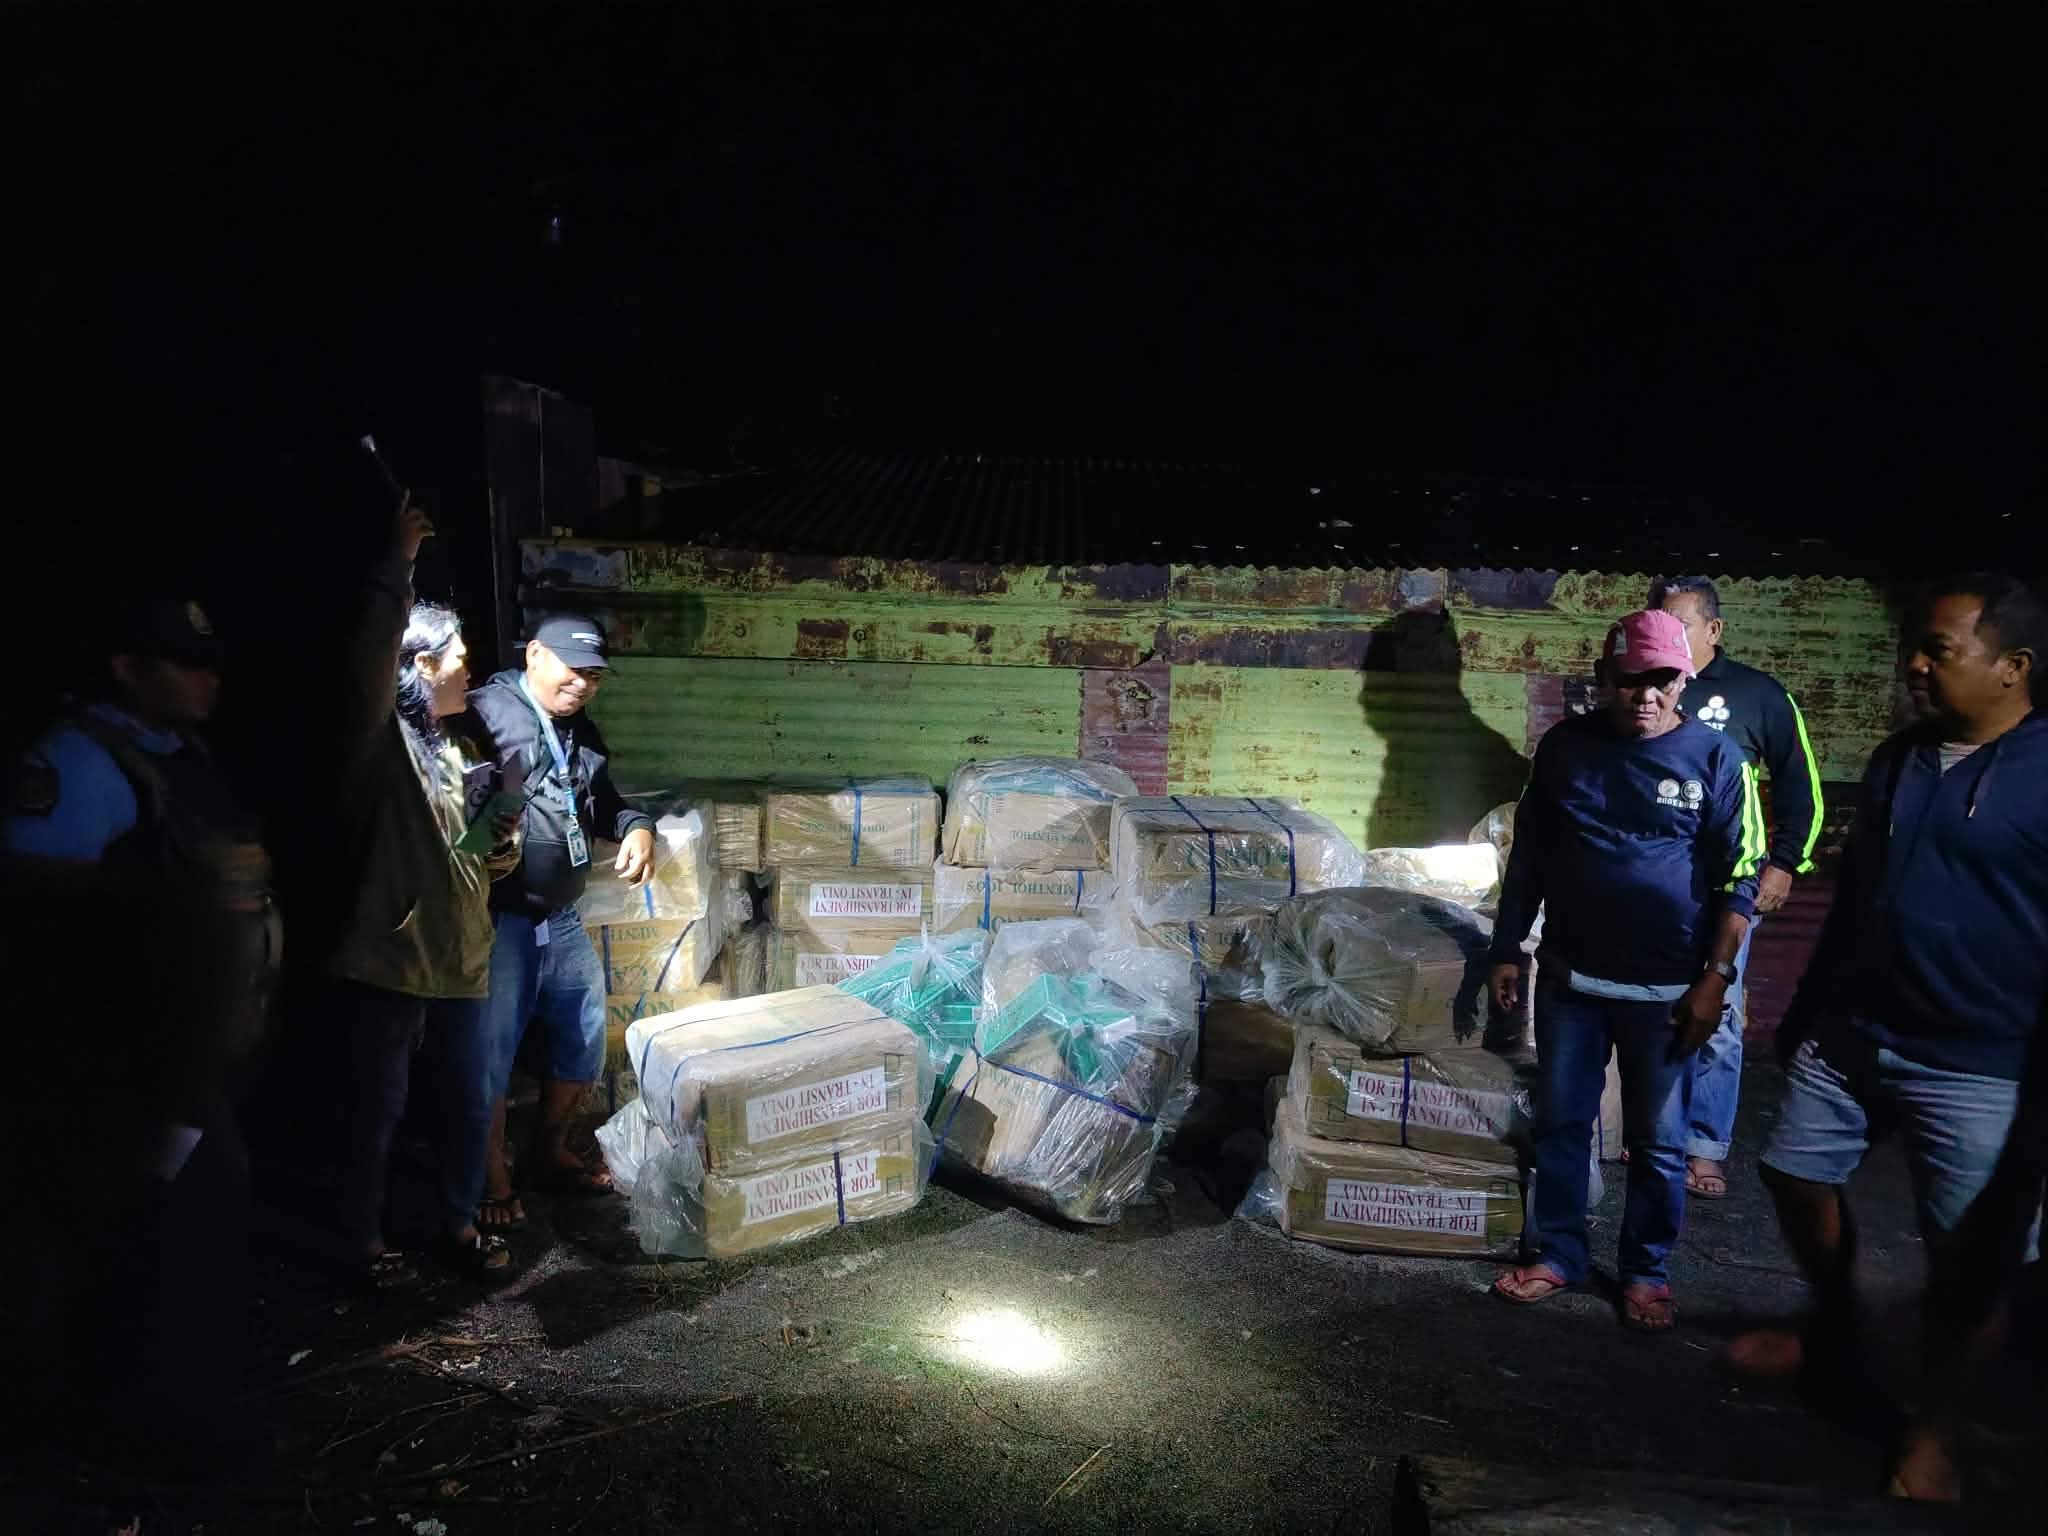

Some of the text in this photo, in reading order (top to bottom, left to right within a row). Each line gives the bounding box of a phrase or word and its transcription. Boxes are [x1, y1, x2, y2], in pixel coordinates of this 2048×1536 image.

[821, 887, 848, 899] ONLY
[1013, 883, 1075, 896] MENTHOL
[815, 901, 916, 913] FOR TRANSHIPMENT
[1357, 1075, 1385, 1097] FOR
[760, 1096, 794, 1117] ONLY
[857, 1092, 881, 1112] FOR
[1455, 1111, 1495, 1133] ONLY
[754, 1176, 789, 1199] ONLY
[851, 1173, 876, 1193] FOR
[1342, 1183, 1379, 1204] ONLY
[1384, 1188, 1444, 1209] TRANSIT
[1330, 1201, 1478, 1232] FOR TRANSHIPMENT
